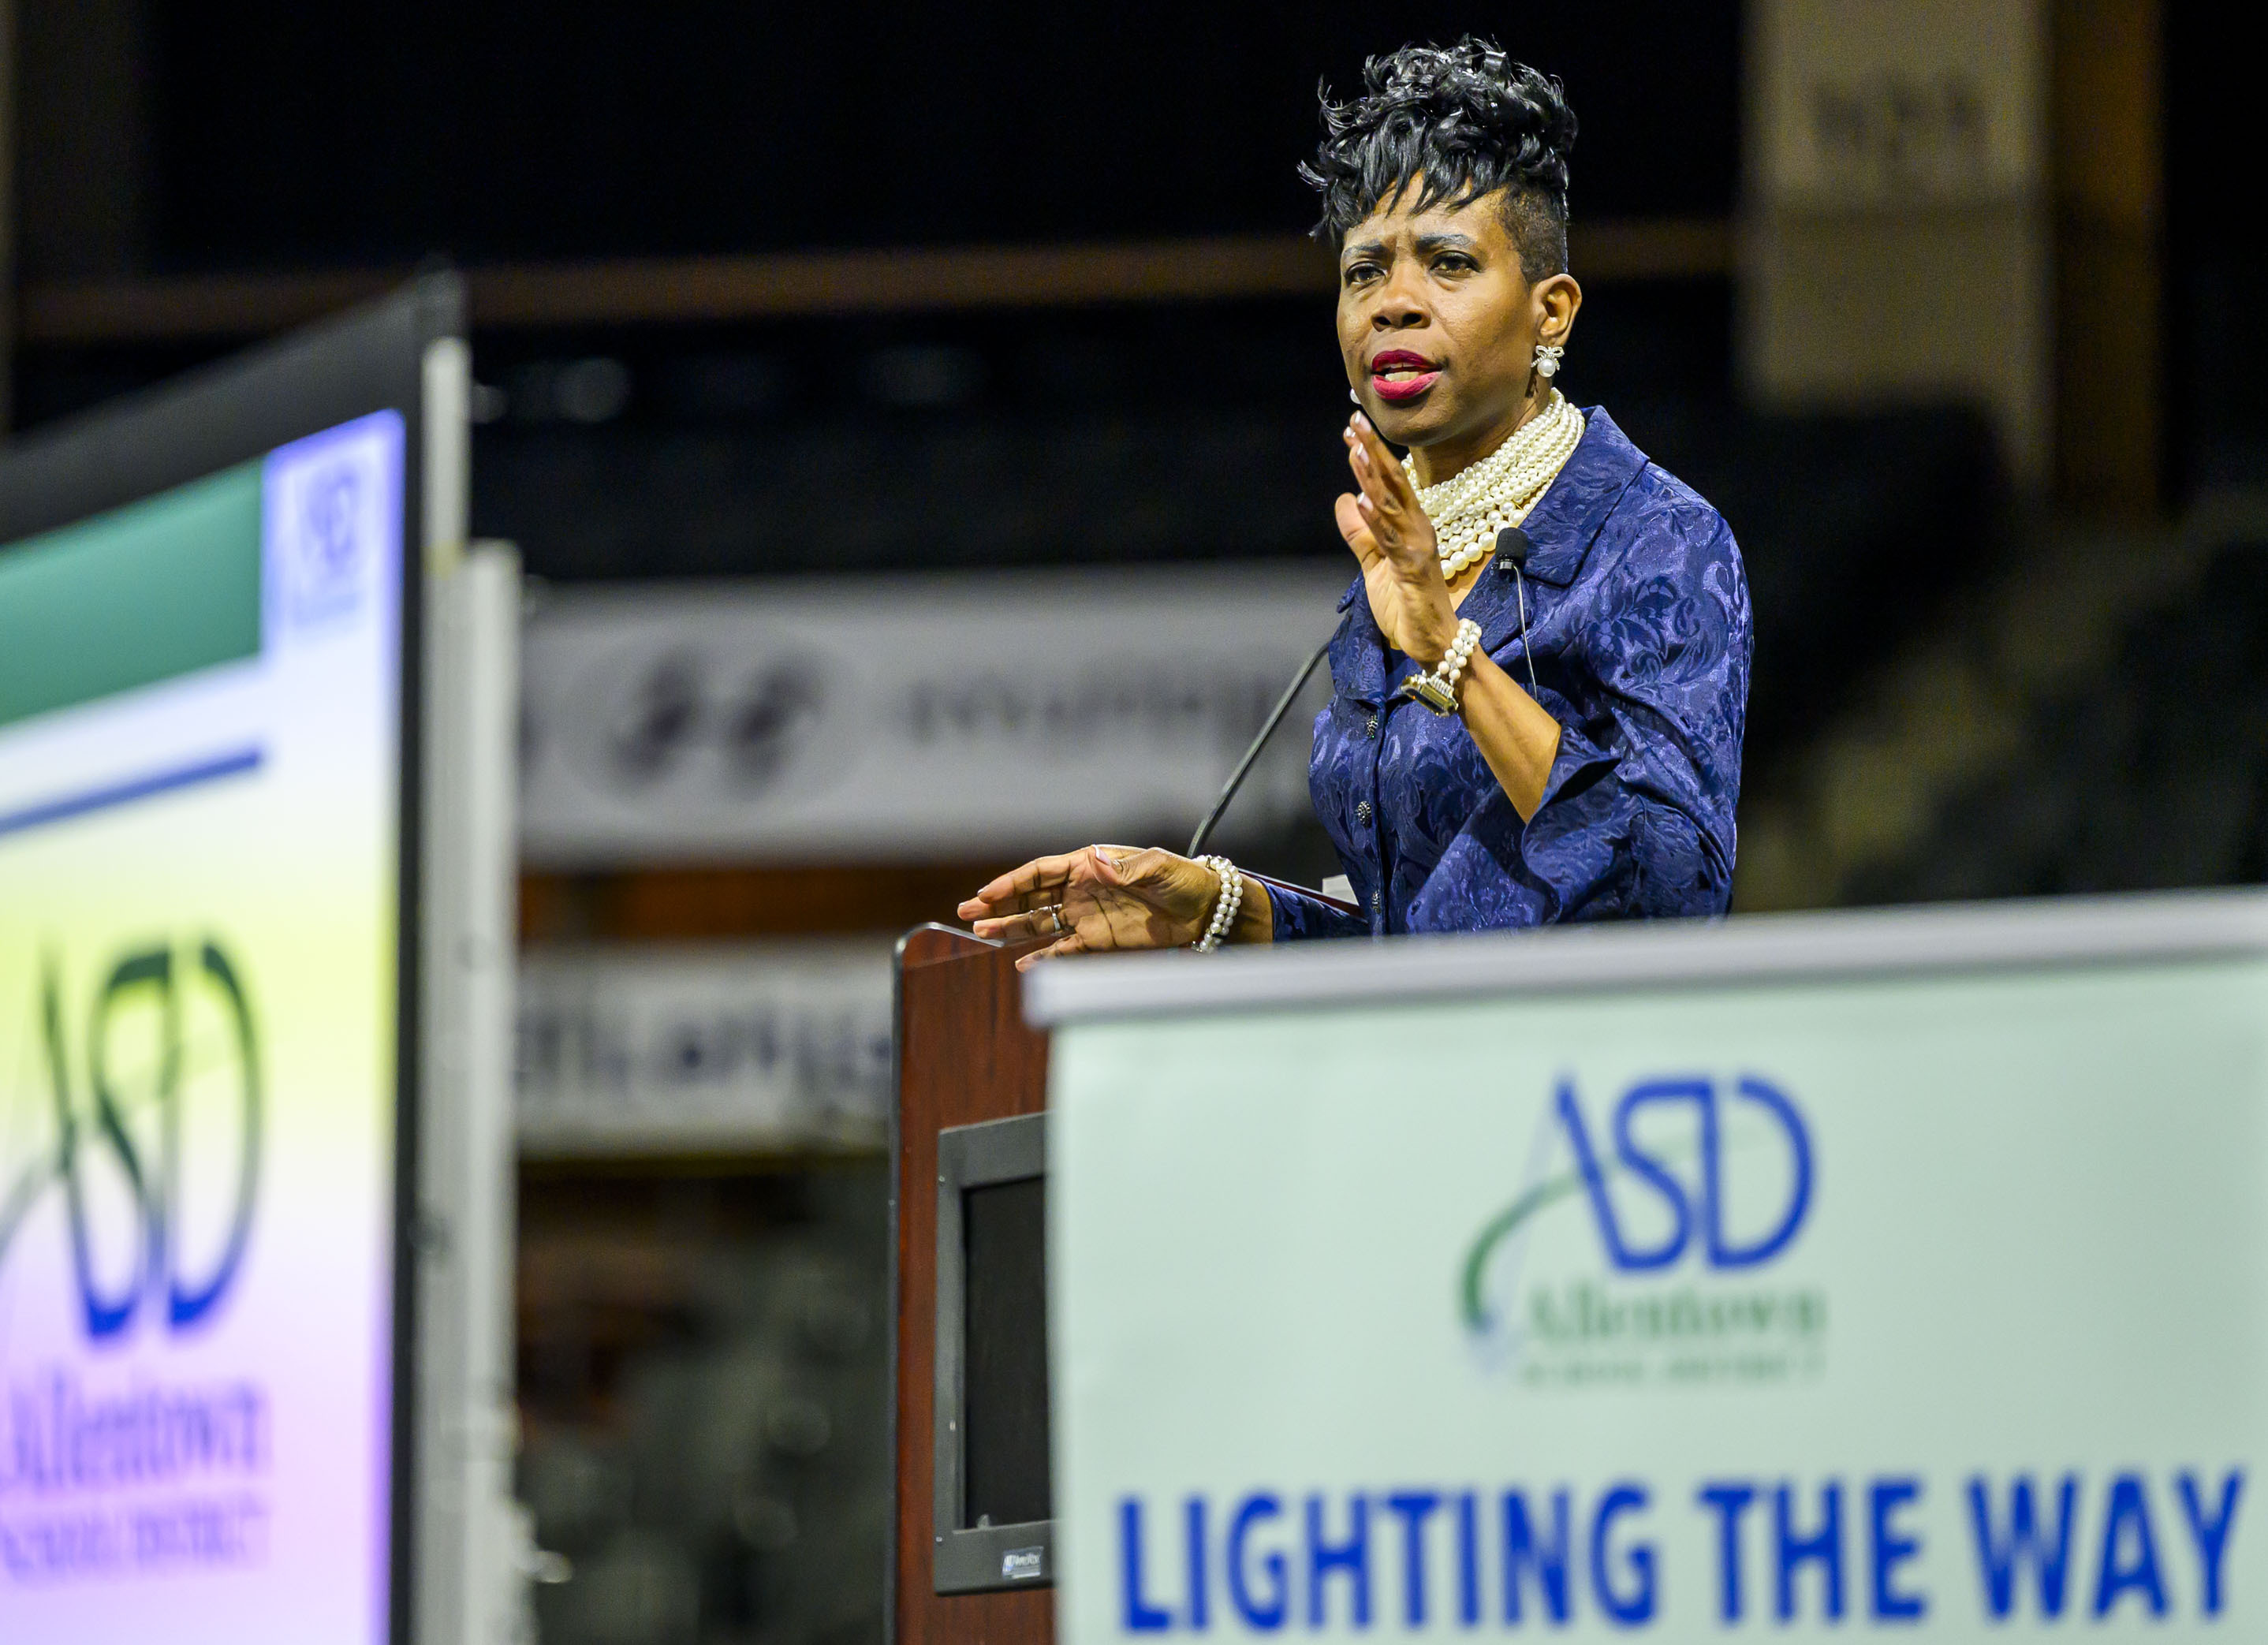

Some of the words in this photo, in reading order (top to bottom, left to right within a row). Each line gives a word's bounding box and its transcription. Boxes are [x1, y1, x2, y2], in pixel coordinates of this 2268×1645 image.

[1554, 1068, 1819, 1278] ASD
[1120, 1487, 1658, 1634] LIGHTING
[1700, 1478, 1926, 1623] THE
[1968, 1468, 2247, 1620] WAY
